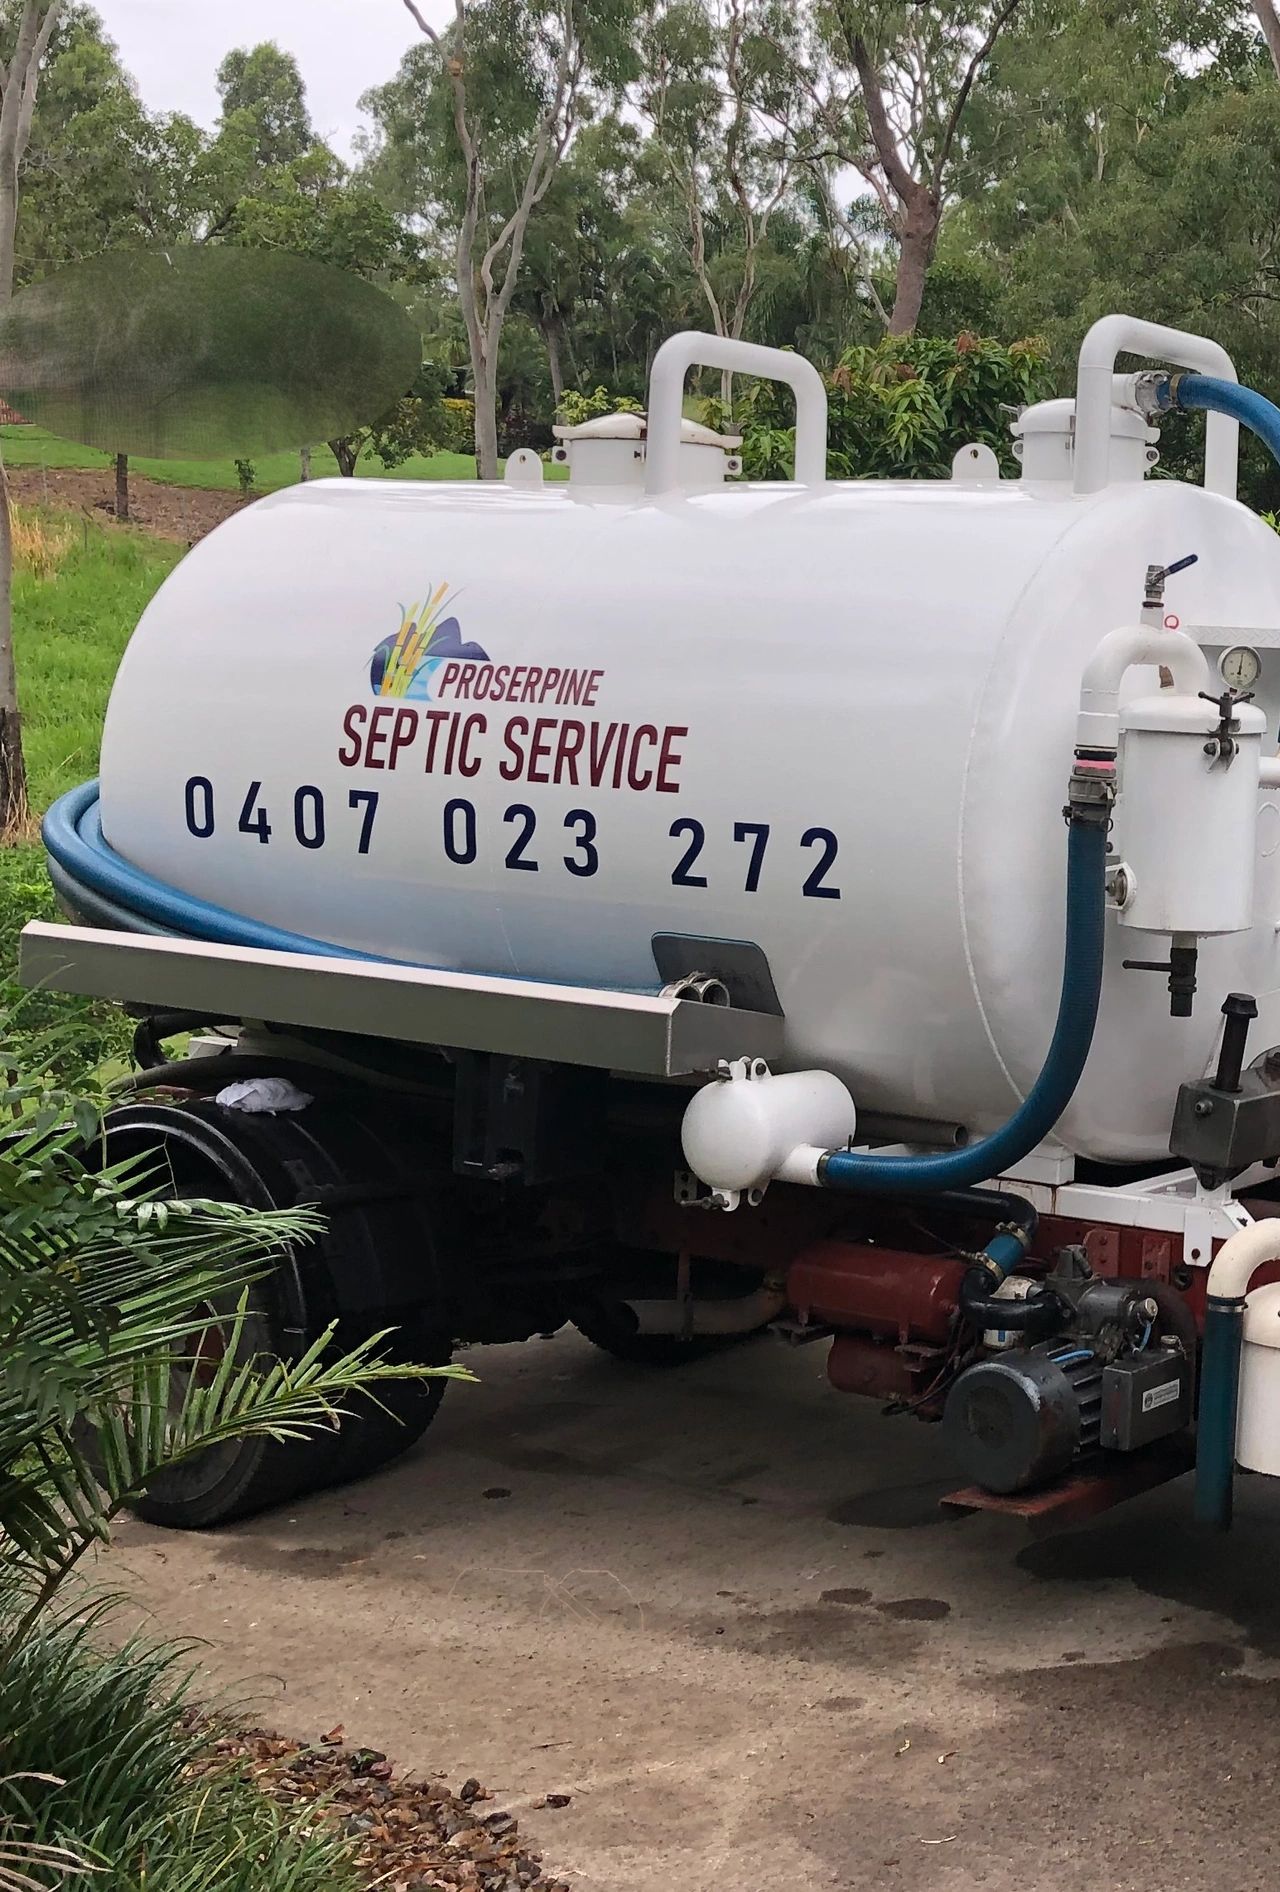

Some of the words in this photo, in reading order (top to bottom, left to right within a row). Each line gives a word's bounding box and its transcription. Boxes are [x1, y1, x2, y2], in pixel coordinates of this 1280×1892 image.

[438, 662, 605, 707] PROSERPINE
[338, 704, 488, 778] SEPTIC
[498, 715, 689, 794] SERVICE
[184, 775, 380, 855] 0407
[443, 798, 599, 878] 023
[668, 817, 841, 900] 272
